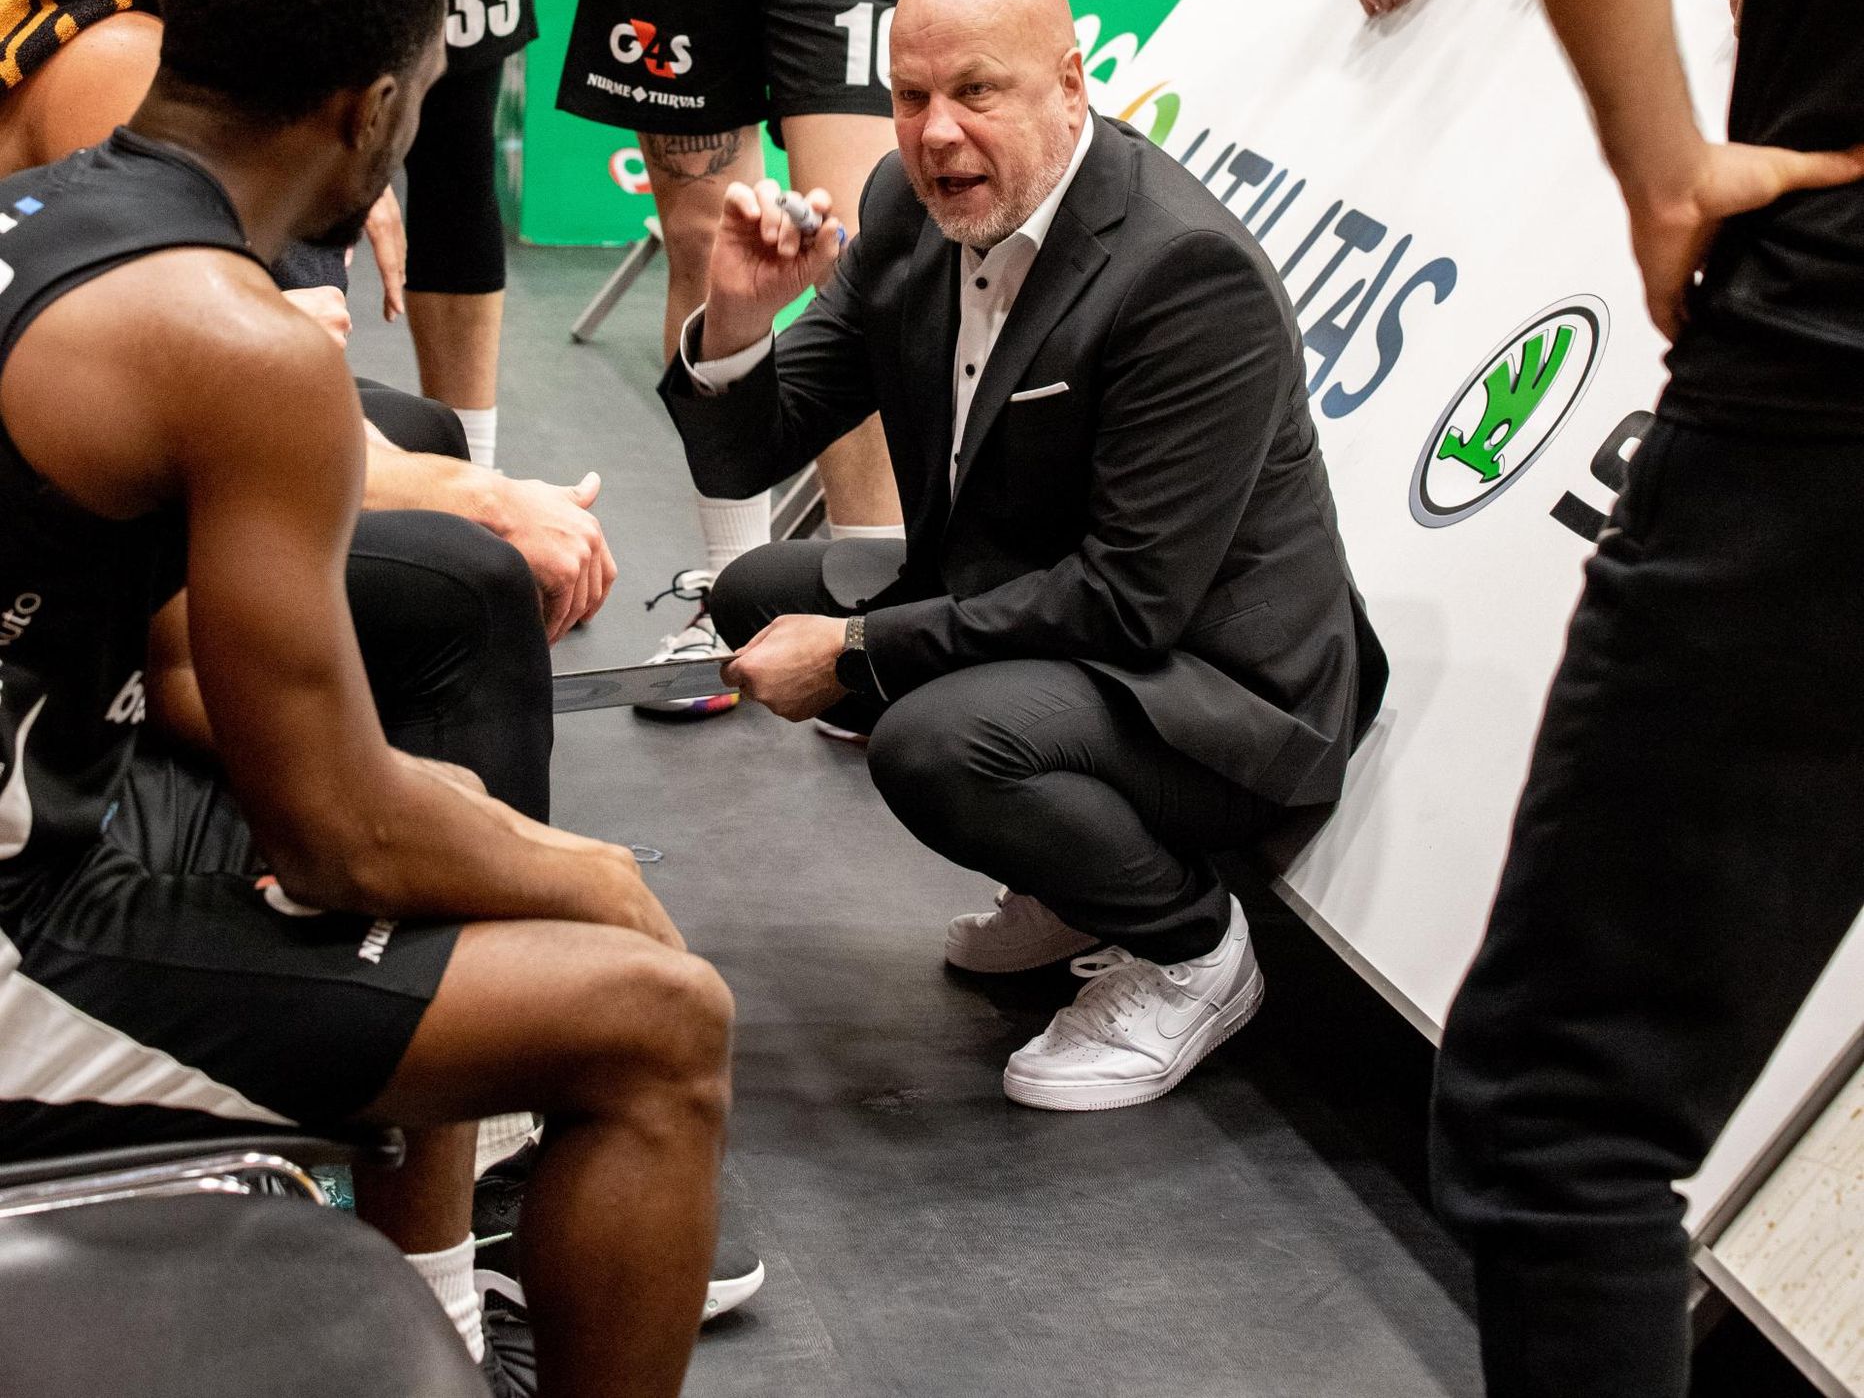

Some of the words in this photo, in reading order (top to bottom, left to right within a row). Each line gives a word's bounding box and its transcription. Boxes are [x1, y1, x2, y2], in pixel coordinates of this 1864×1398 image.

[609, 18, 693, 79] G4S
[587, 72, 632, 98] NURME
[648, 90, 706, 109] TURVAS
[0, 592, 42, 646] uto
